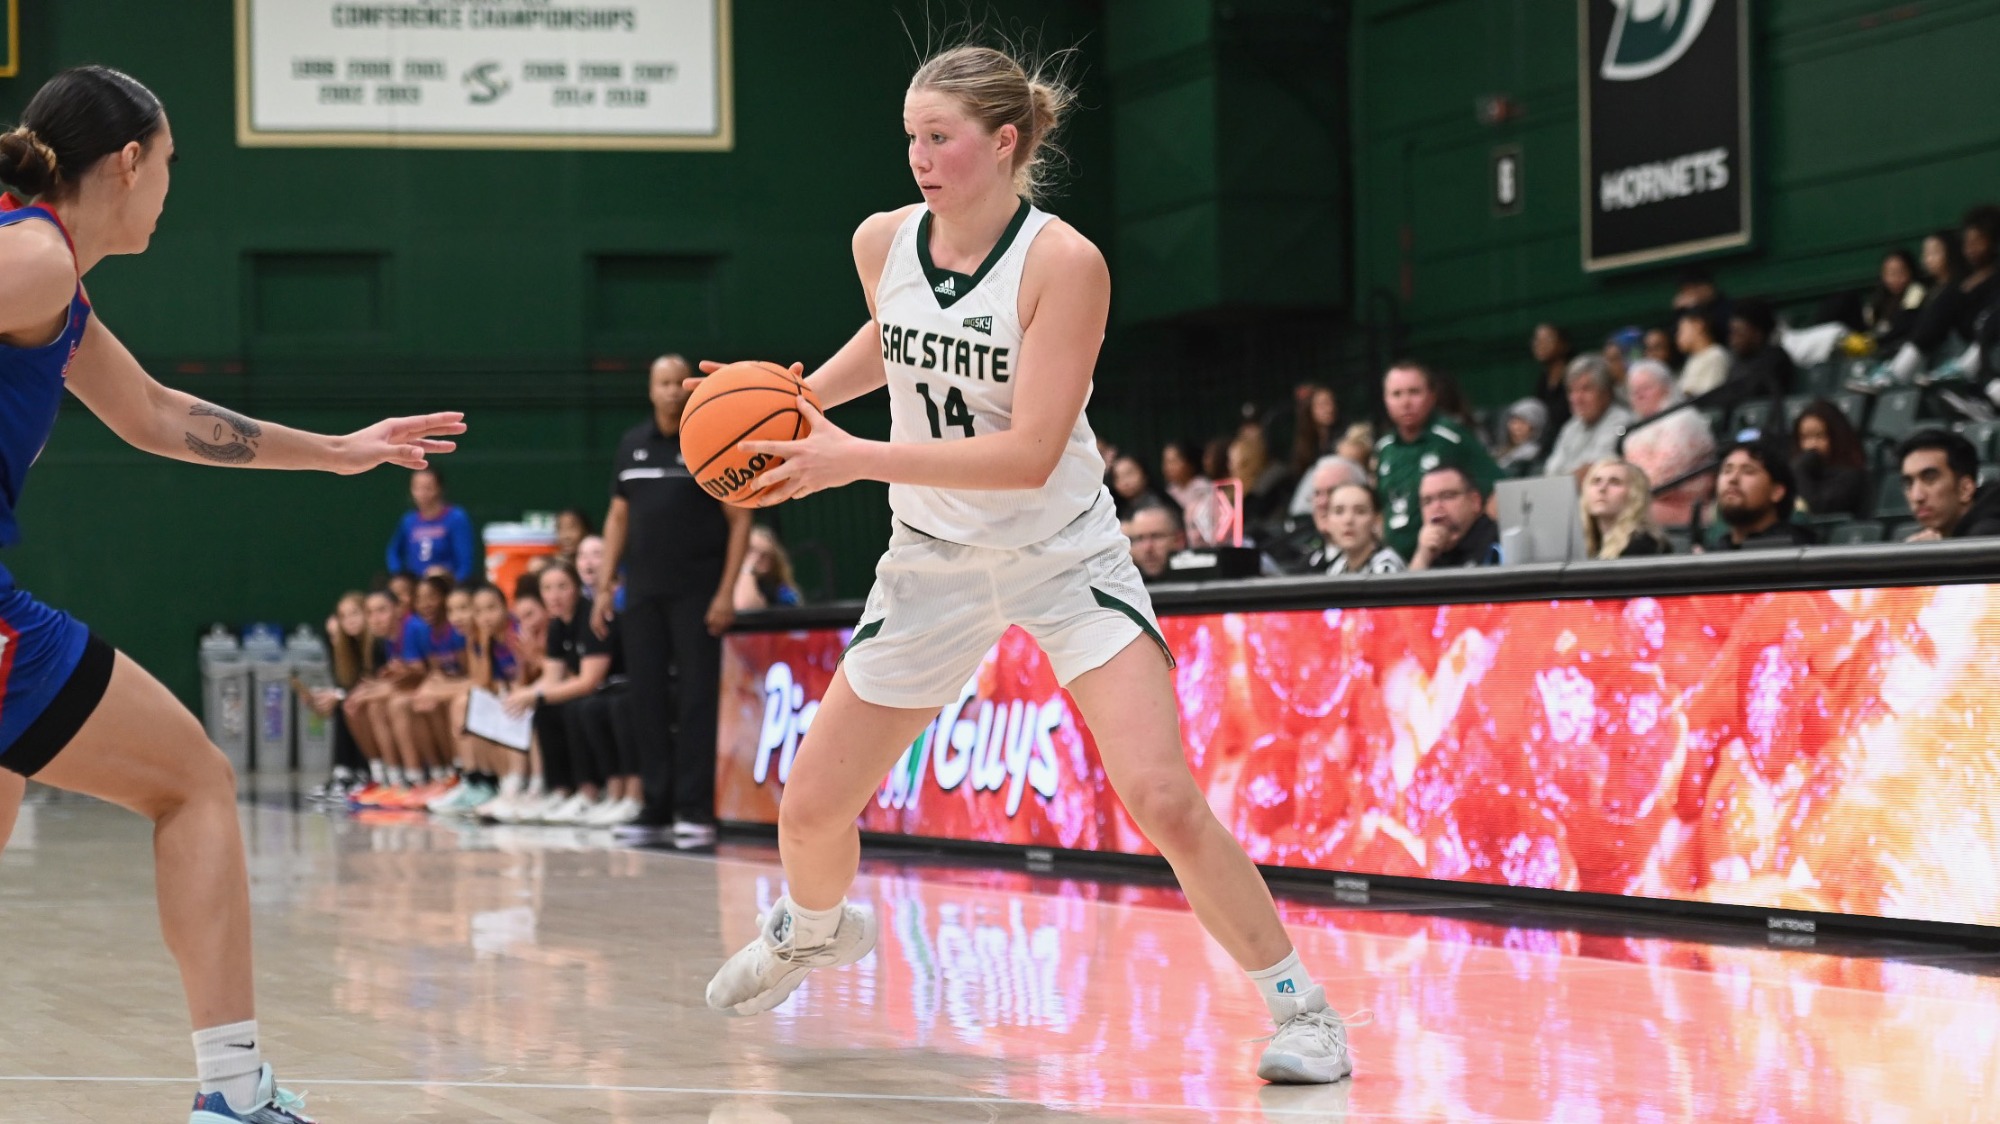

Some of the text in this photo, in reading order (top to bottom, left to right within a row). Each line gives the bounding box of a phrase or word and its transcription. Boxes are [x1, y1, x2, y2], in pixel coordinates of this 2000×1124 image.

[331, 5, 637, 31] CONFERENCE CHAMPIONSHIPS
[1600, 147, 1729, 211] HORNETS
[934, 285, 956, 297] adidas
[882, 324, 1011, 383] SAC STATE
[915, 382, 975, 439] 14
[932, 678, 1063, 817] Guys
